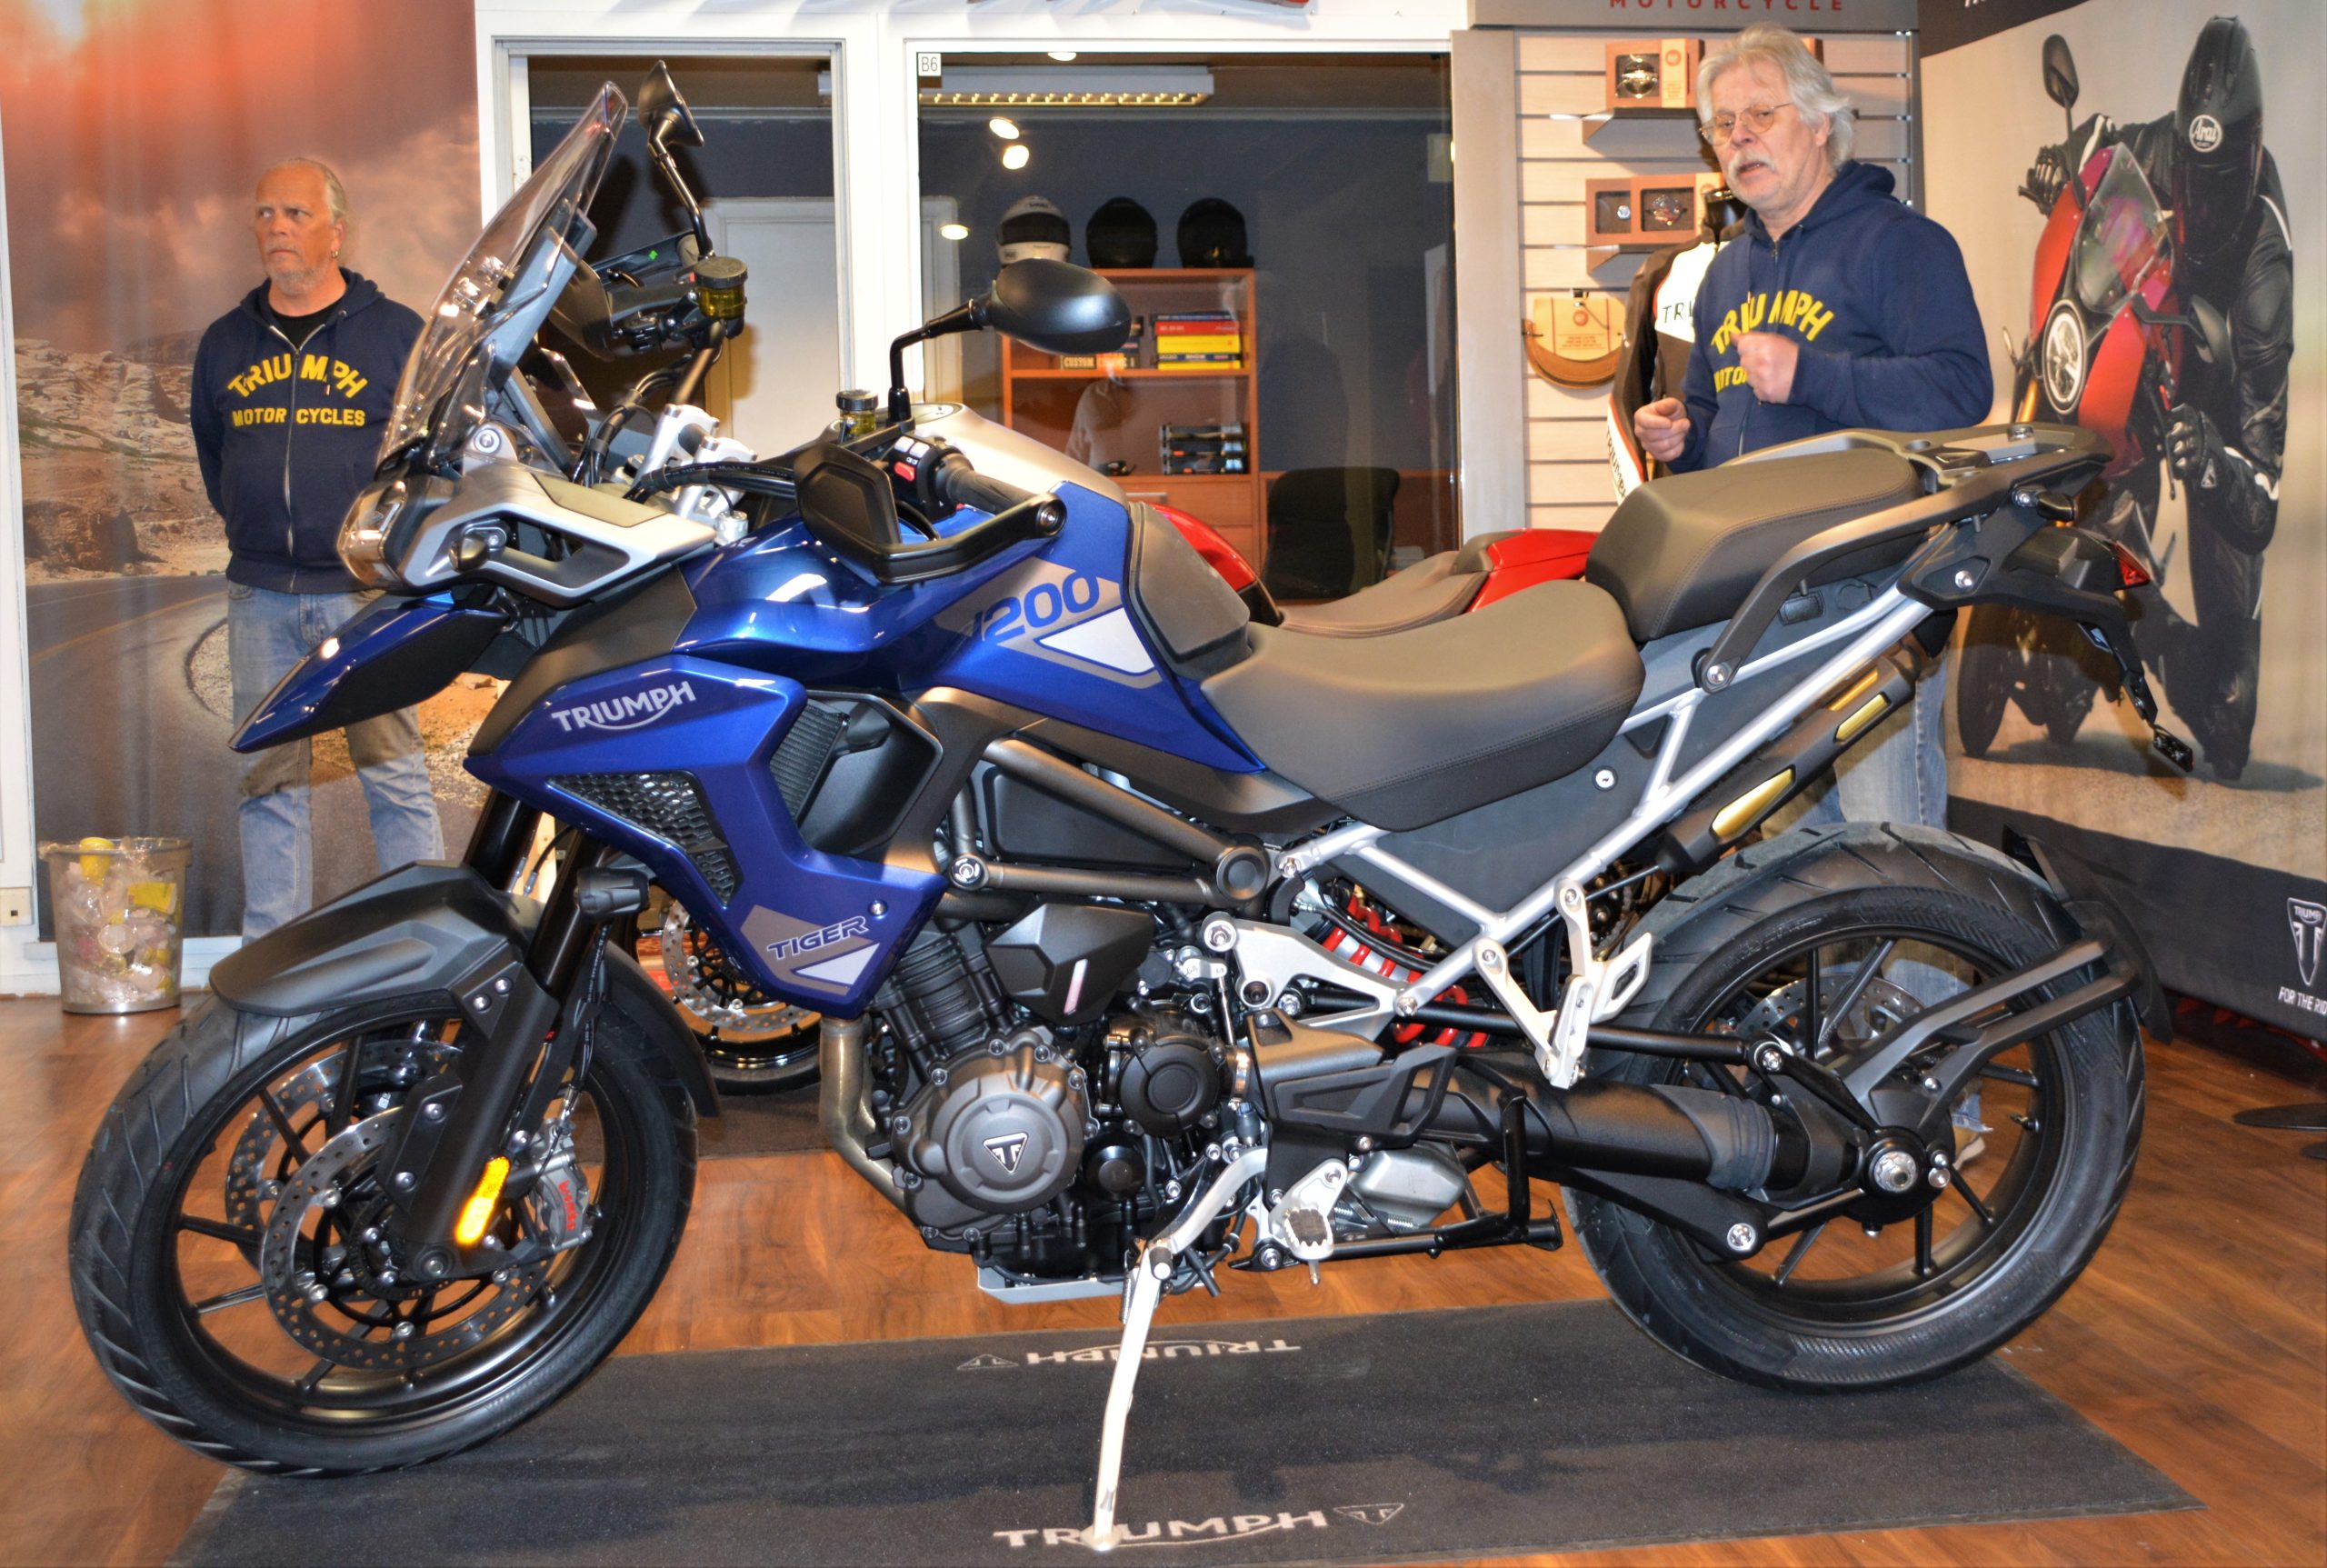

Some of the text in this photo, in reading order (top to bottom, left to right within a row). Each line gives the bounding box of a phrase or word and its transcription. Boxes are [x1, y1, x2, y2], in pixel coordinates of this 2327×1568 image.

[1609, 0, 1843, 11] MOTORCYCLE
[921, 56, 938, 73] B6
[1711, 289, 1834, 355] TRIUMPH
[227, 353, 368, 398] TRIUMPH
[232, 408, 366, 426] MOTOR CYCLES
[971, 570, 1100, 642] 1200
[551, 681, 696, 732] TRIUMPH
[766, 915, 869, 960] TIGER
[2278, 986, 2327, 1015] FOR THE RID
[994, 1510, 1328, 1547] TRUMPH
